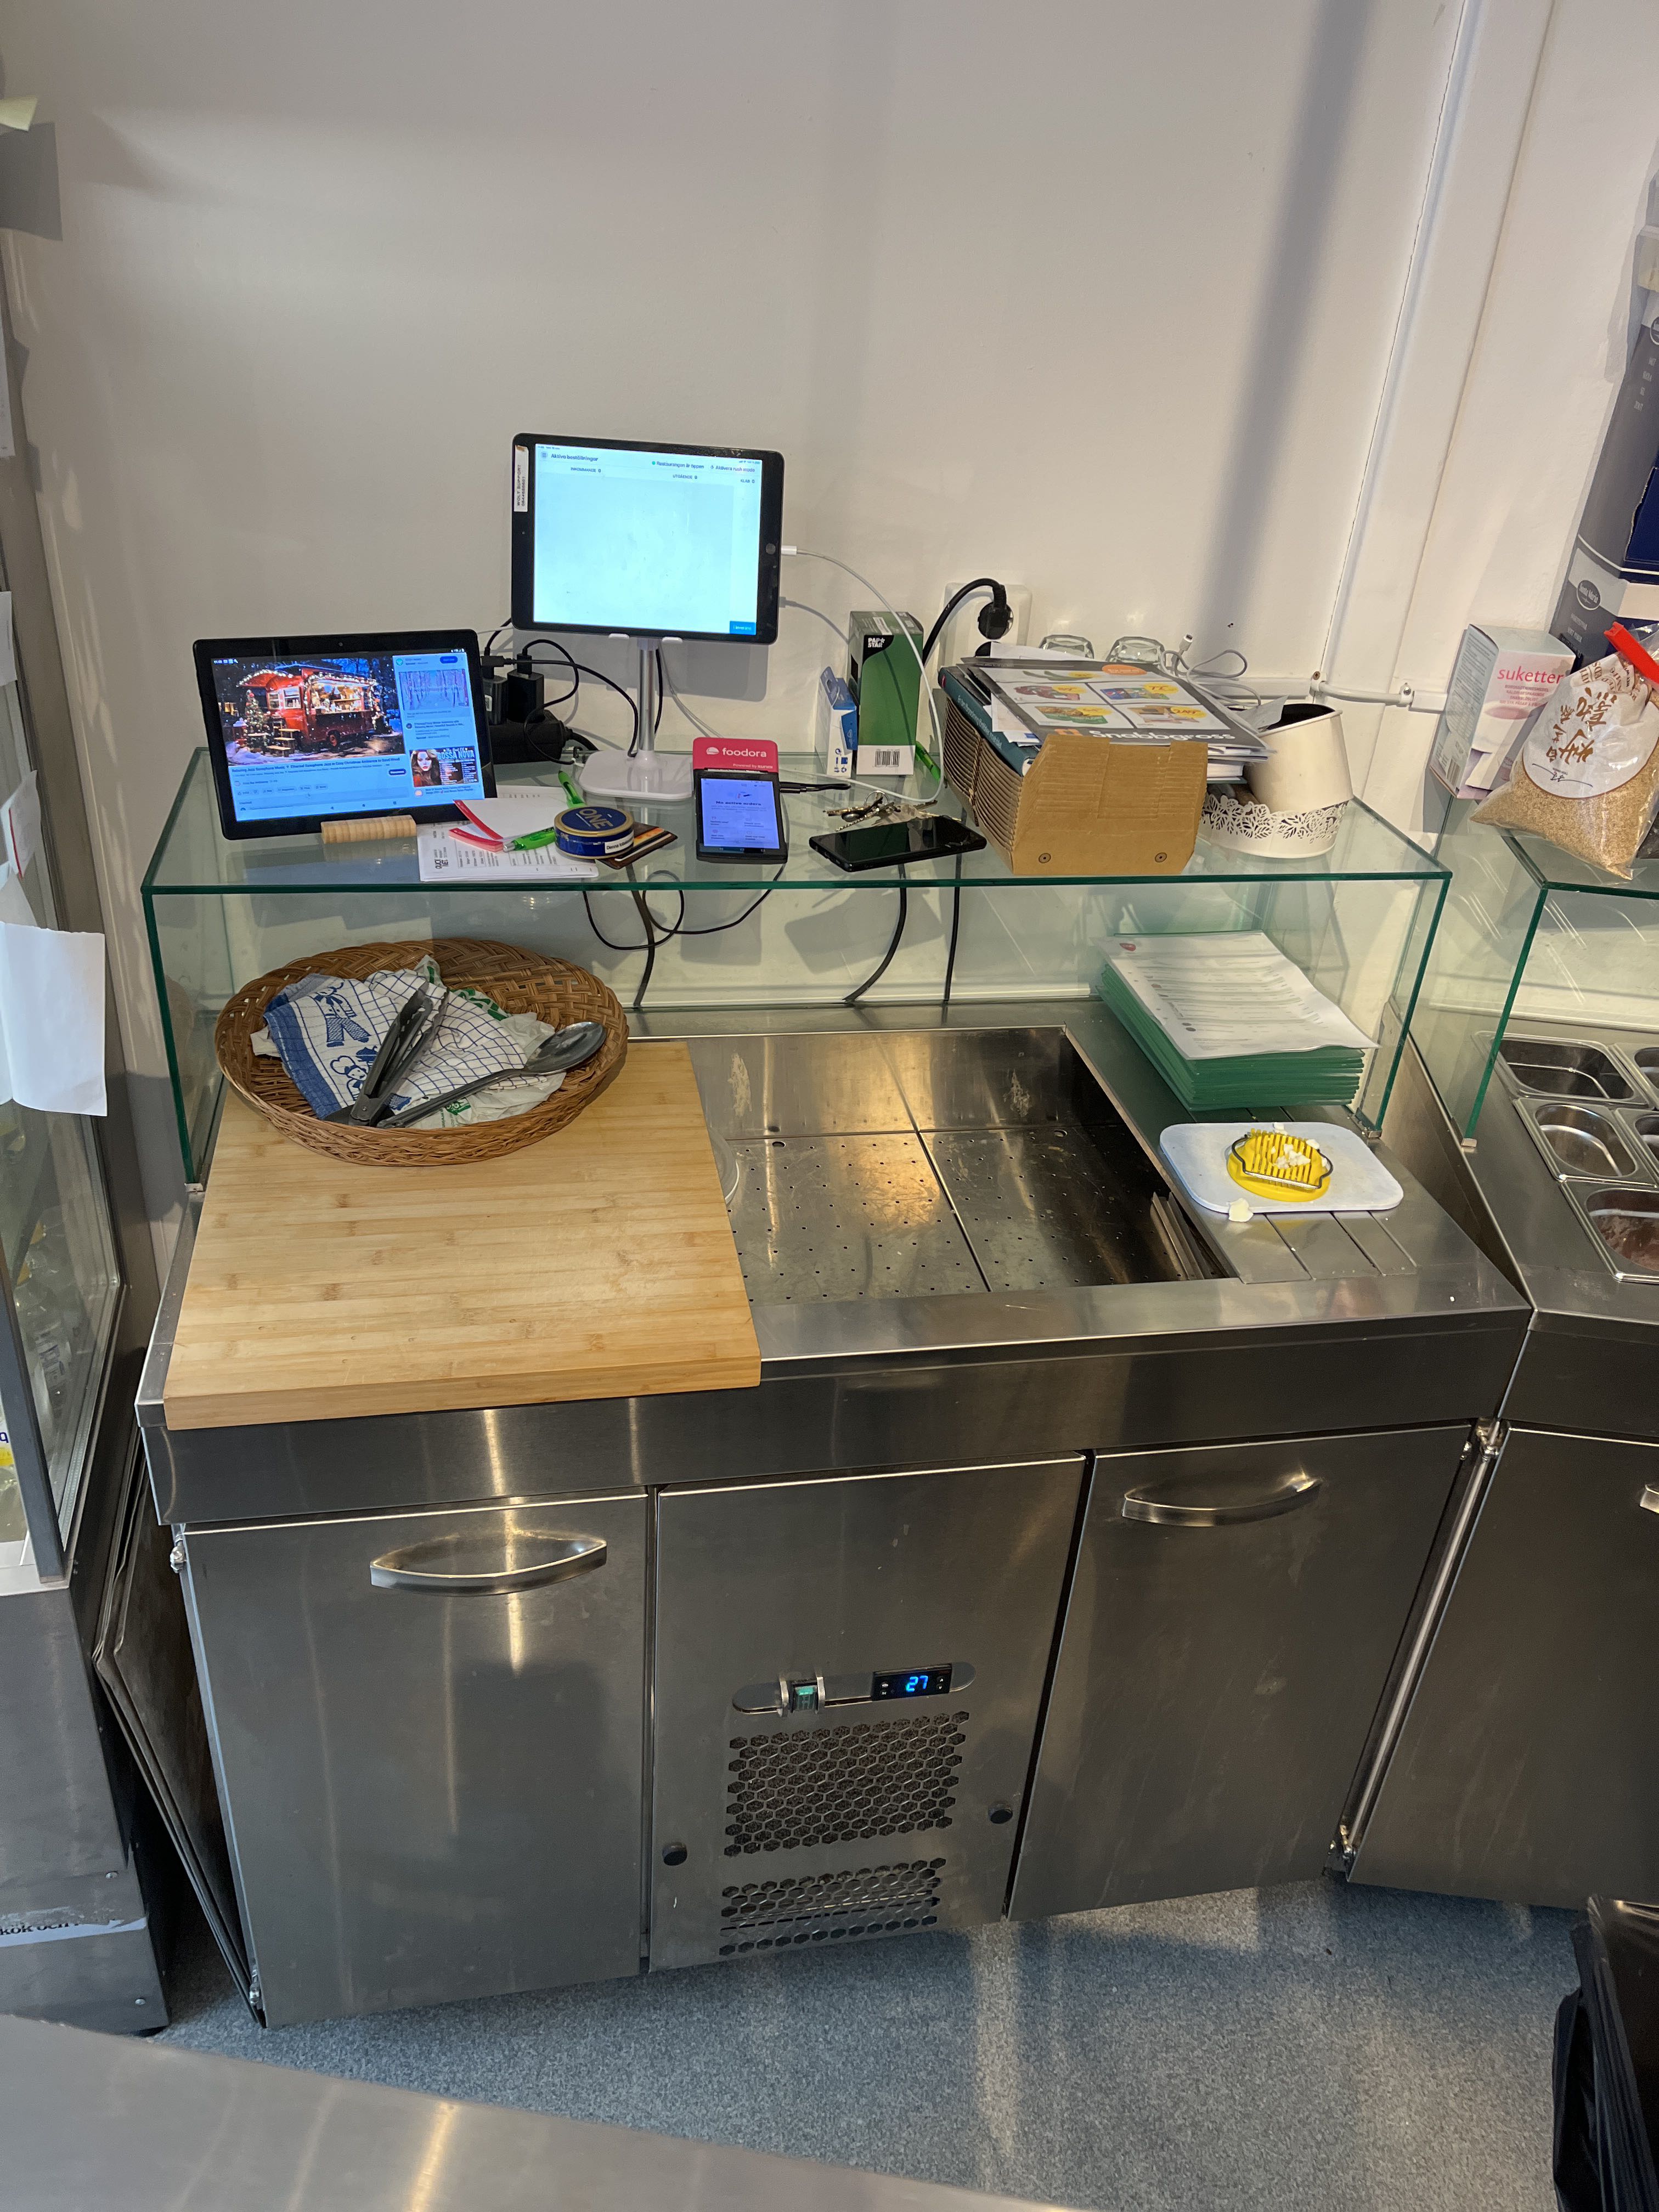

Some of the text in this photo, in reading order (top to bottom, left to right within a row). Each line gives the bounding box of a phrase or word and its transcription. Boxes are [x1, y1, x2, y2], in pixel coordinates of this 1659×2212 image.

[1497, 665, 1564, 684] suketter
[1088, 730, 1235, 741] Snabbgross
[459, 749, 475, 758] NOVA
[722, 747, 767, 758] foodora
[579, 808, 613, 830] ONE
[906, 1675, 929, 1692] 27
